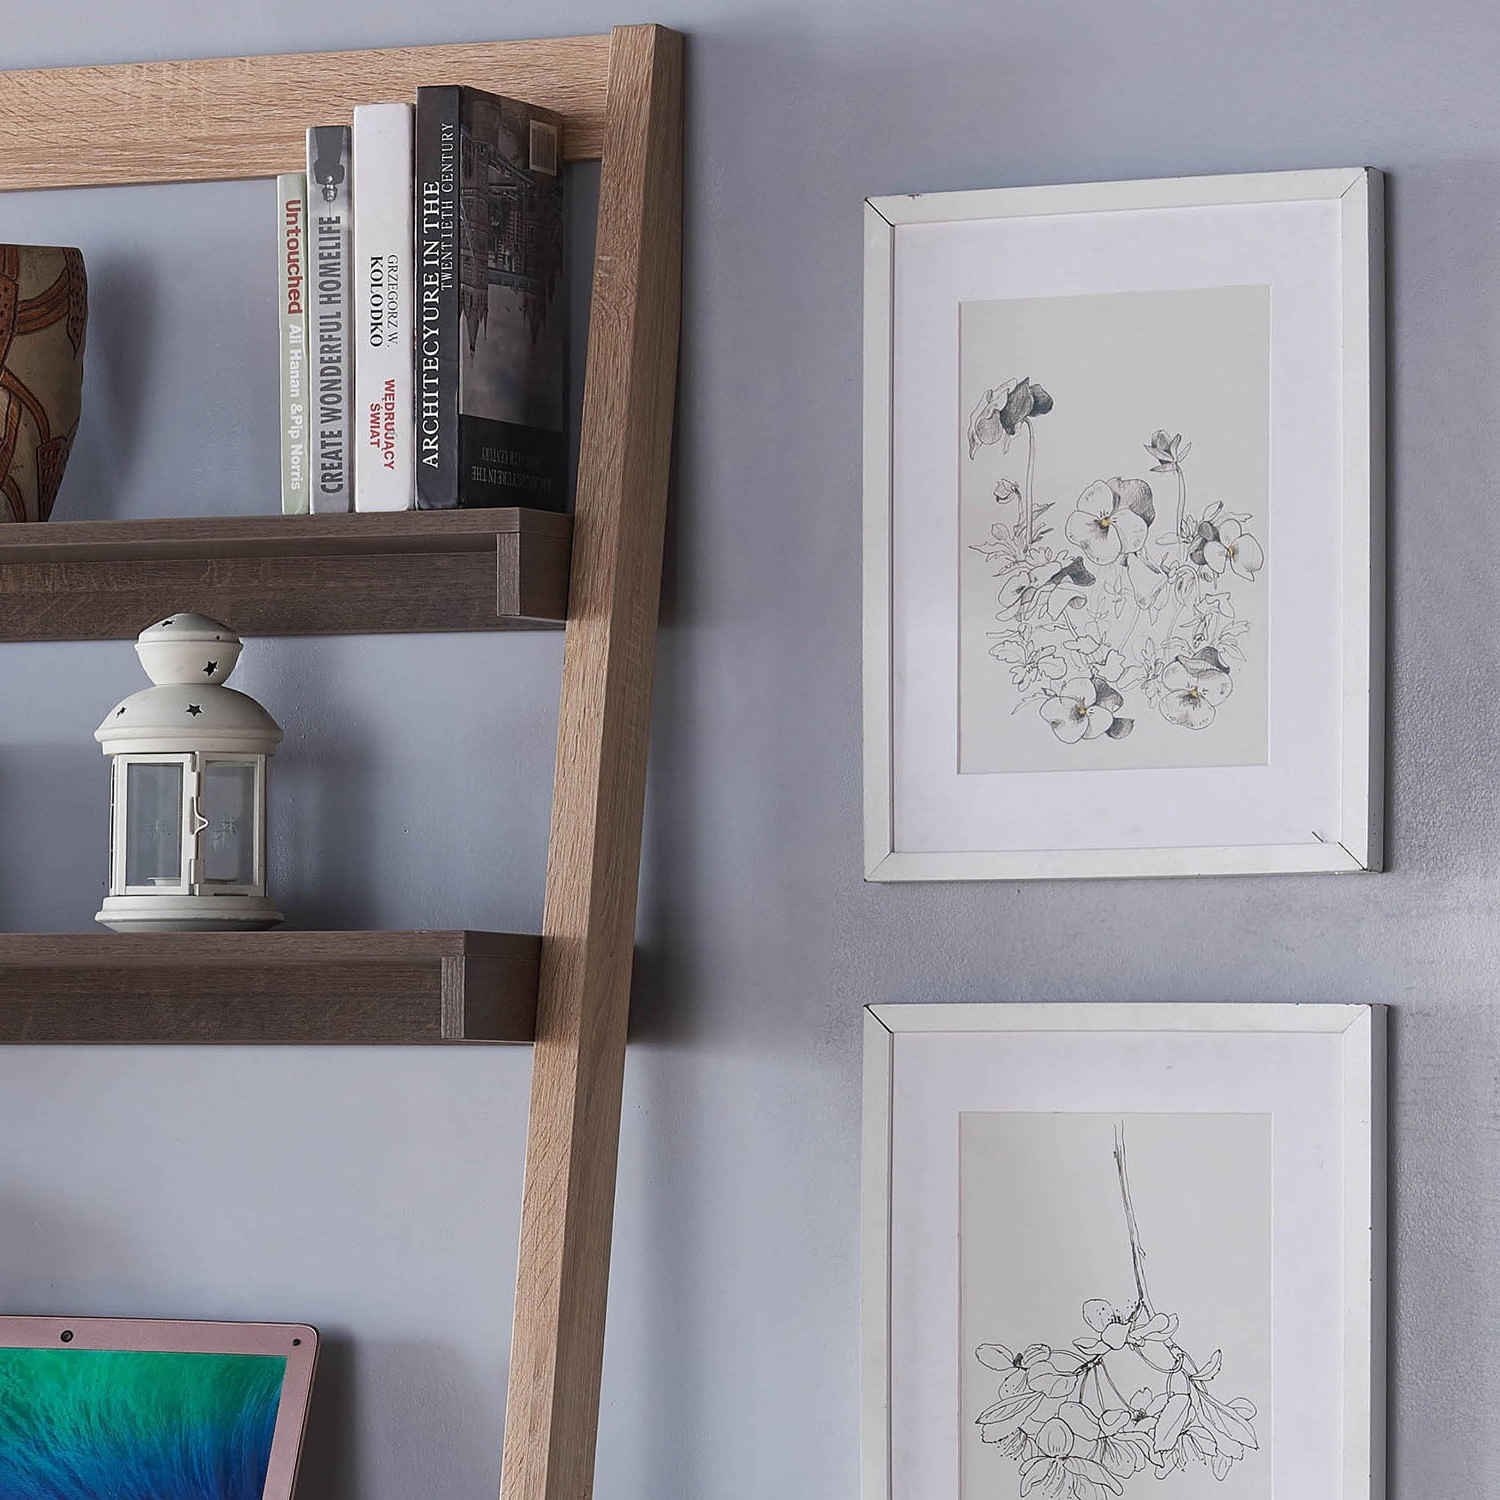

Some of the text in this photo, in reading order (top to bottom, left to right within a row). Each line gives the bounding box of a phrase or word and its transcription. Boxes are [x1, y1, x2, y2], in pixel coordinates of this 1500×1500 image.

[441, 122, 454, 291] TWENTIETH CENTURY
[285, 199, 303, 315] Untouched
[369, 255, 384, 348] KOLODKO
[387, 254, 399, 329] GRZEGORZ
[289, 323, 302, 344] Ali
[318, 215, 343, 494] CREATE WONDERFUL HOMELIFE
[422, 181, 440, 468] ARCHITECYURE IN THE
[289, 348, 302, 398] Hanan
[290, 443, 304, 491] Norris
[370, 402, 382, 448] ŚWIAT
[382, 379, 396, 470] WĘDRUJĄCY
